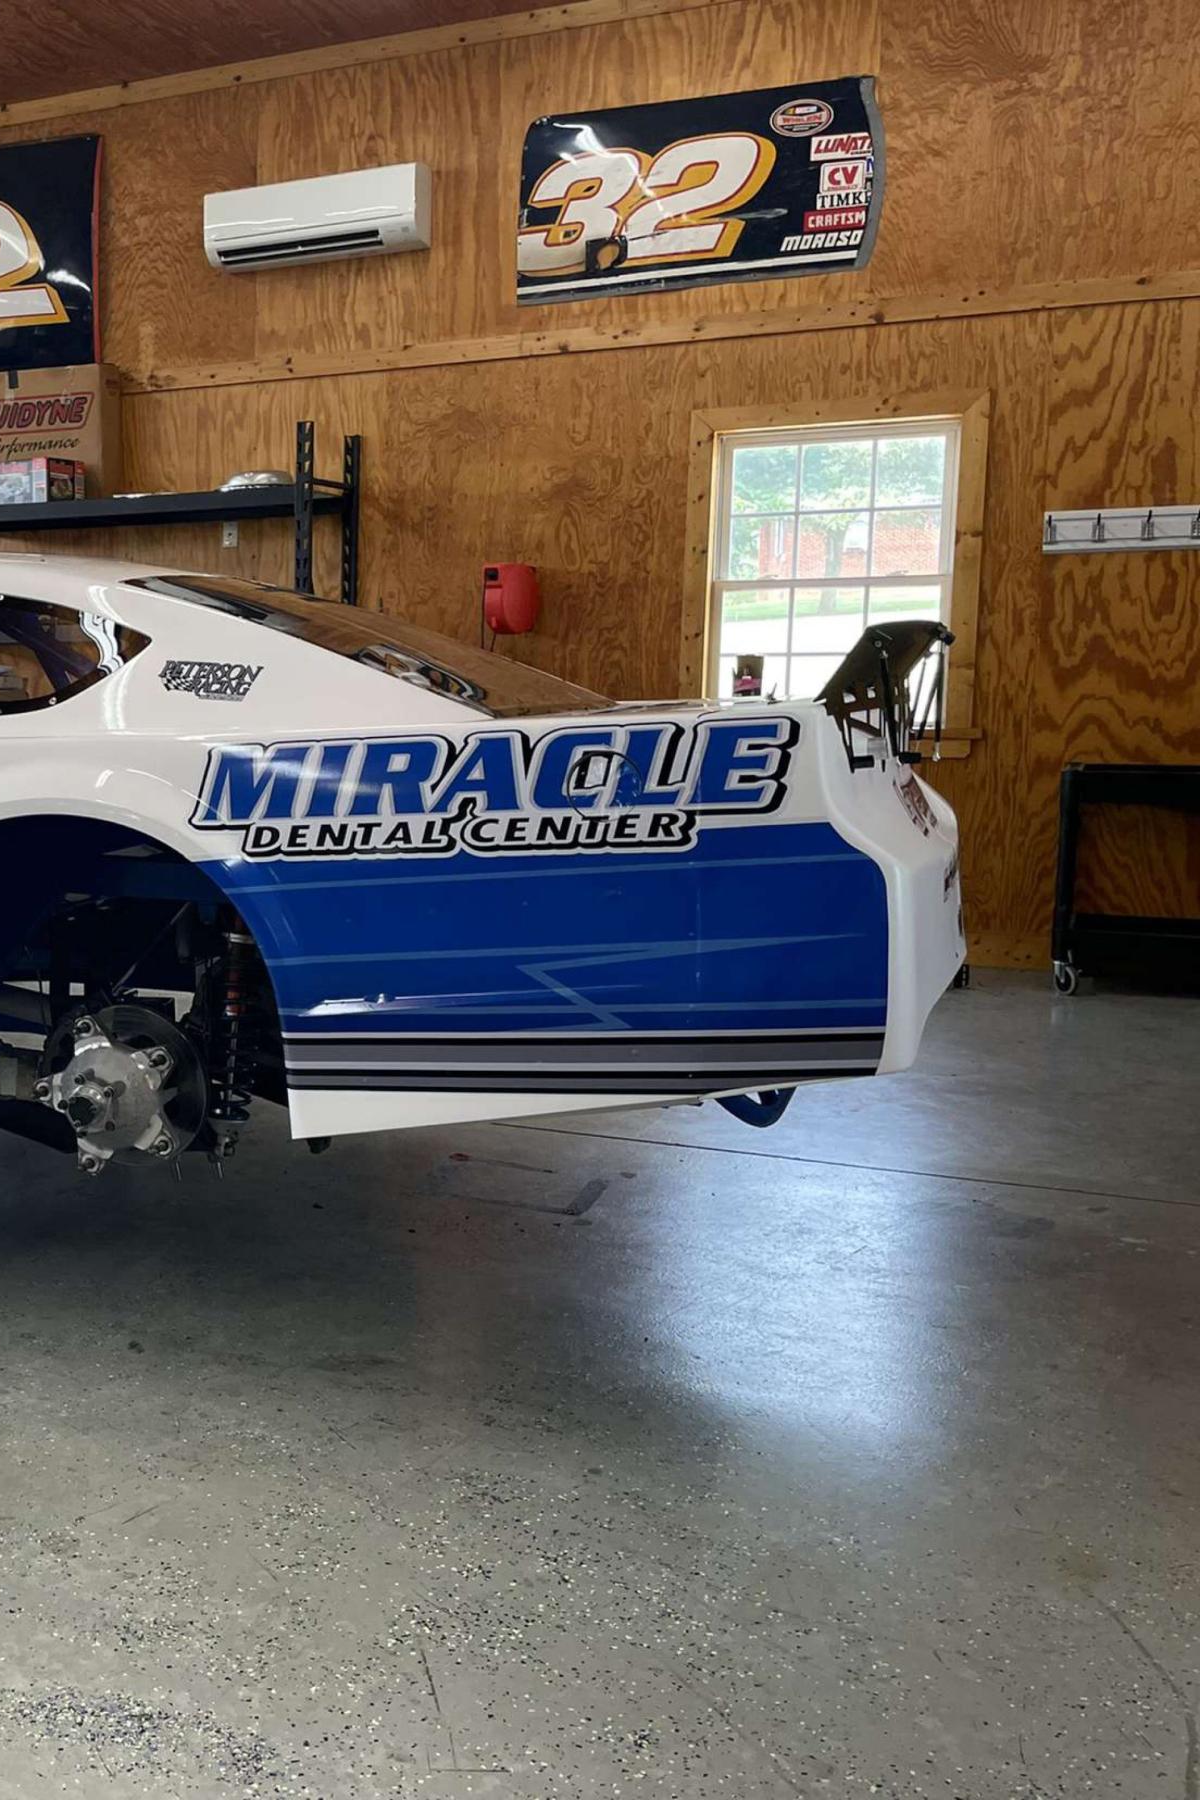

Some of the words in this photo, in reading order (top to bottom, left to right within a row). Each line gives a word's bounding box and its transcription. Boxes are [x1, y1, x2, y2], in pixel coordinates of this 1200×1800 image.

[828, 165, 859, 186] CV
[517, 132, 777, 277] 32
[780, 229, 864, 251] MOROSO
[158, 660, 264, 682] PETERSON
[194, 677, 252, 696] RACING
[197, 719, 790, 825] MIRACLE
[250, 817, 443, 851] DENTAL
[469, 811, 681, 843] CENTER
